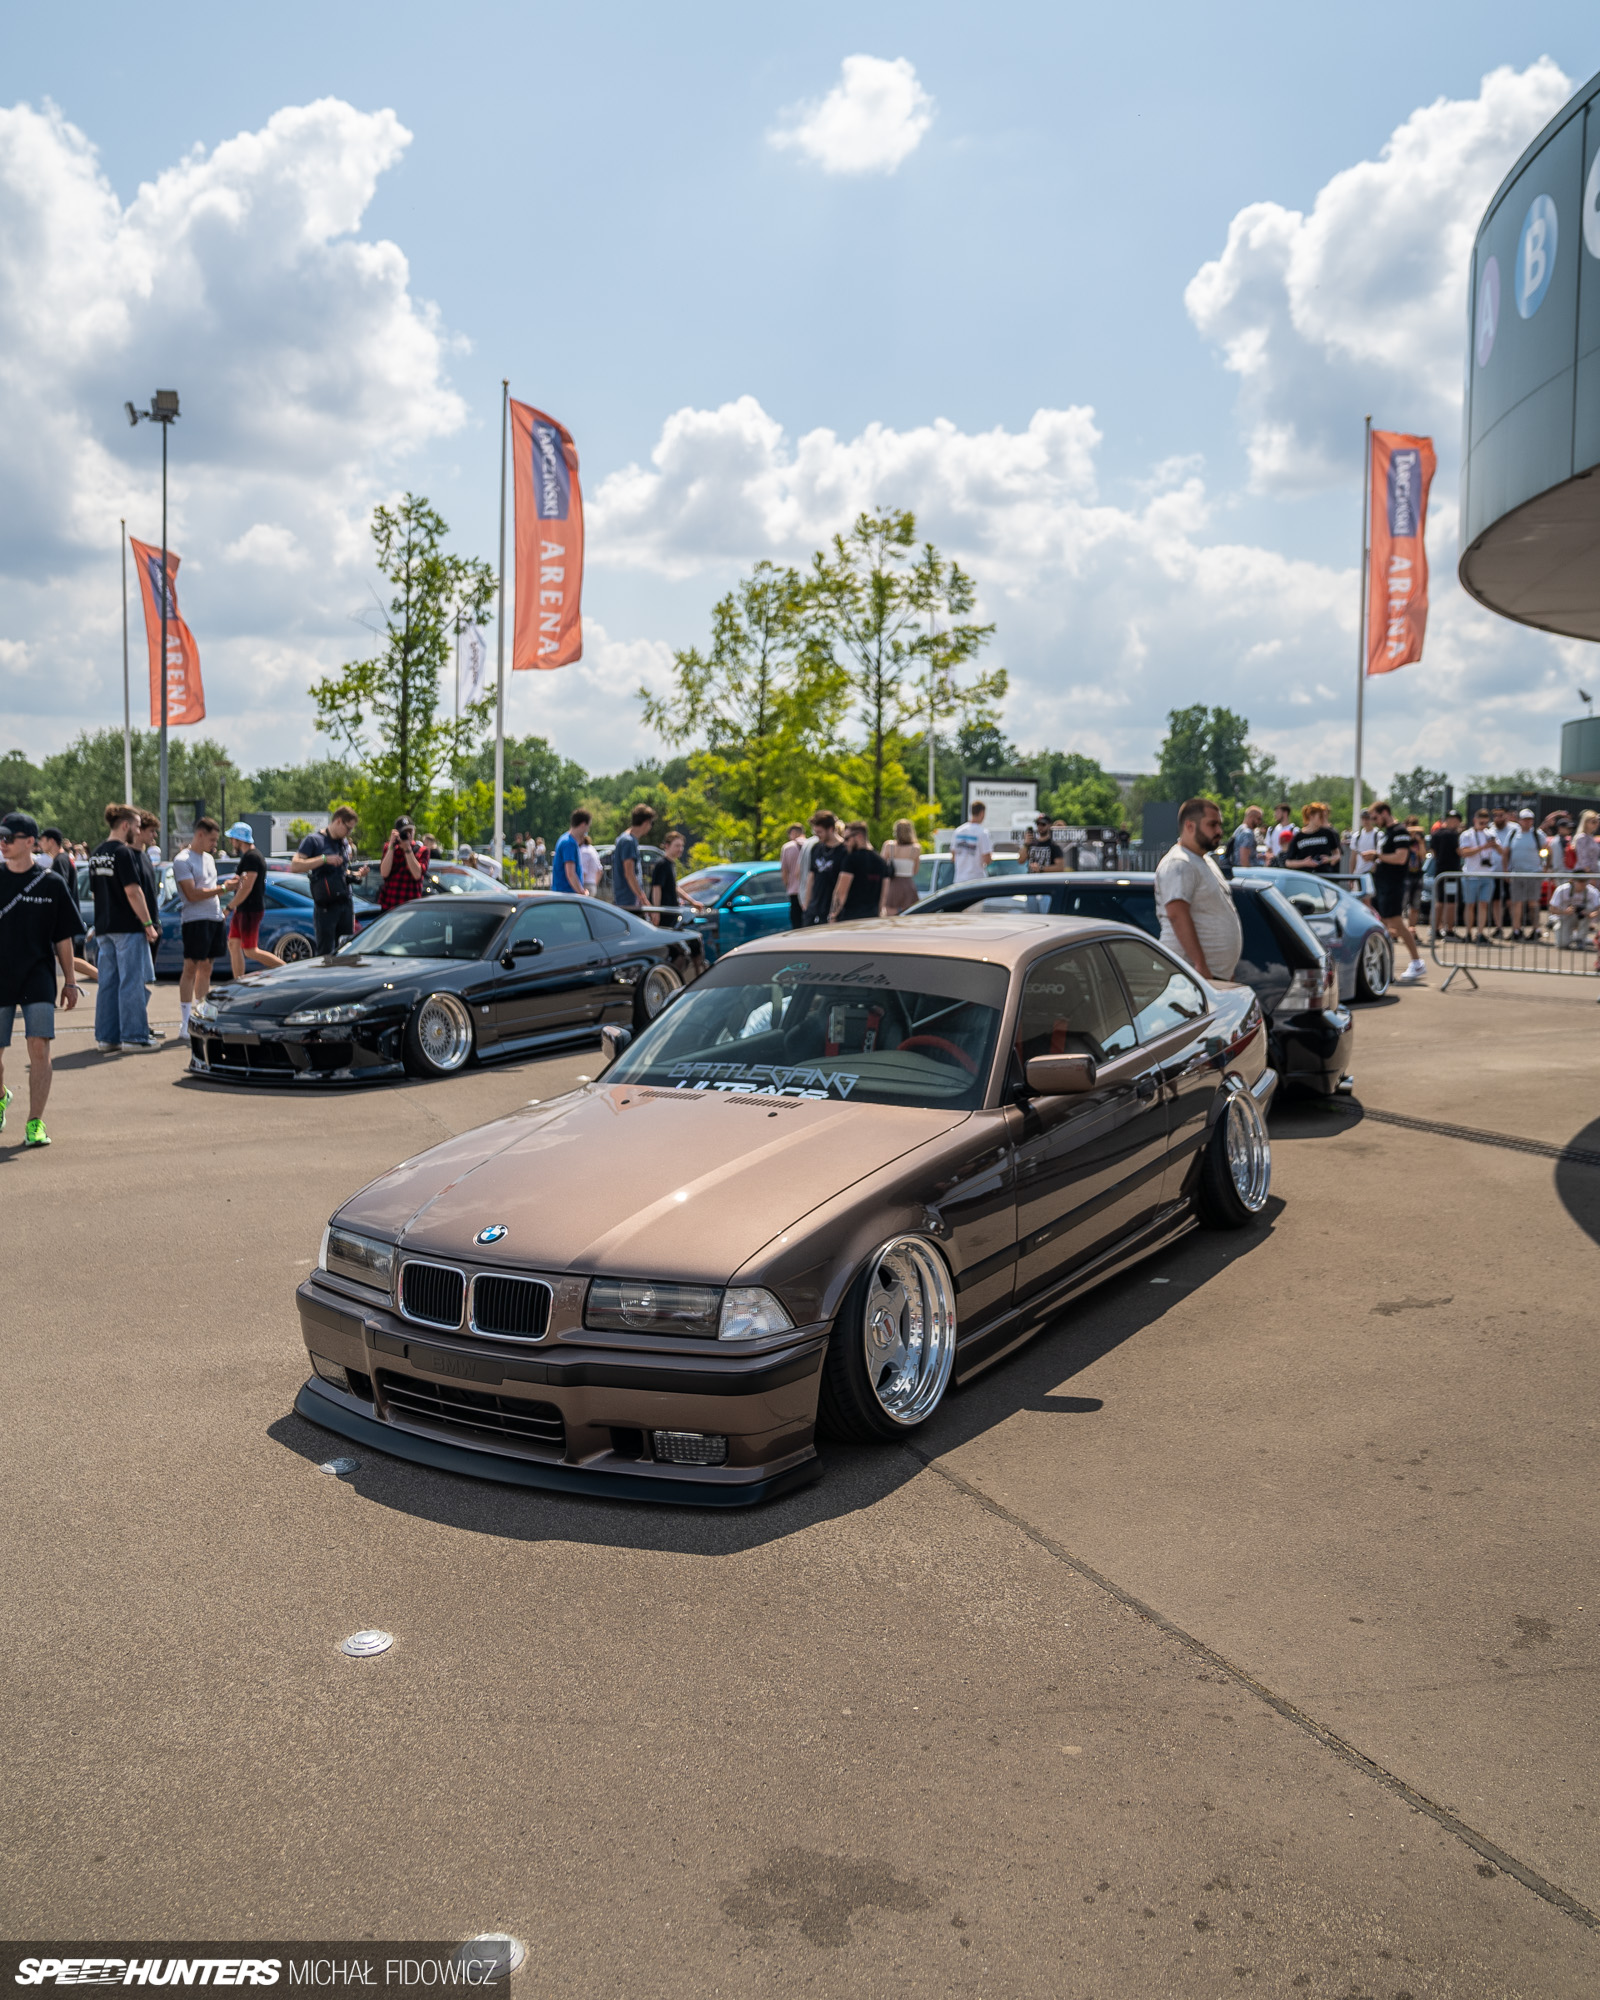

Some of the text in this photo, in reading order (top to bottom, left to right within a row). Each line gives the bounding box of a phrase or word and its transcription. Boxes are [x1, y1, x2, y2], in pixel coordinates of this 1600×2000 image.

[1523, 218, 1547, 299] B
[1477, 280, 1495, 354] A
[537, 540, 565, 656] ARENA
[1387, 555, 1412, 660] ARENA
[166, 633, 187, 717] ARENA
[1025, 982, 1065, 995] ECARO
[667, 1062, 860, 1099] BATTLEGANG
[431, 1353, 476, 1378] BMW
